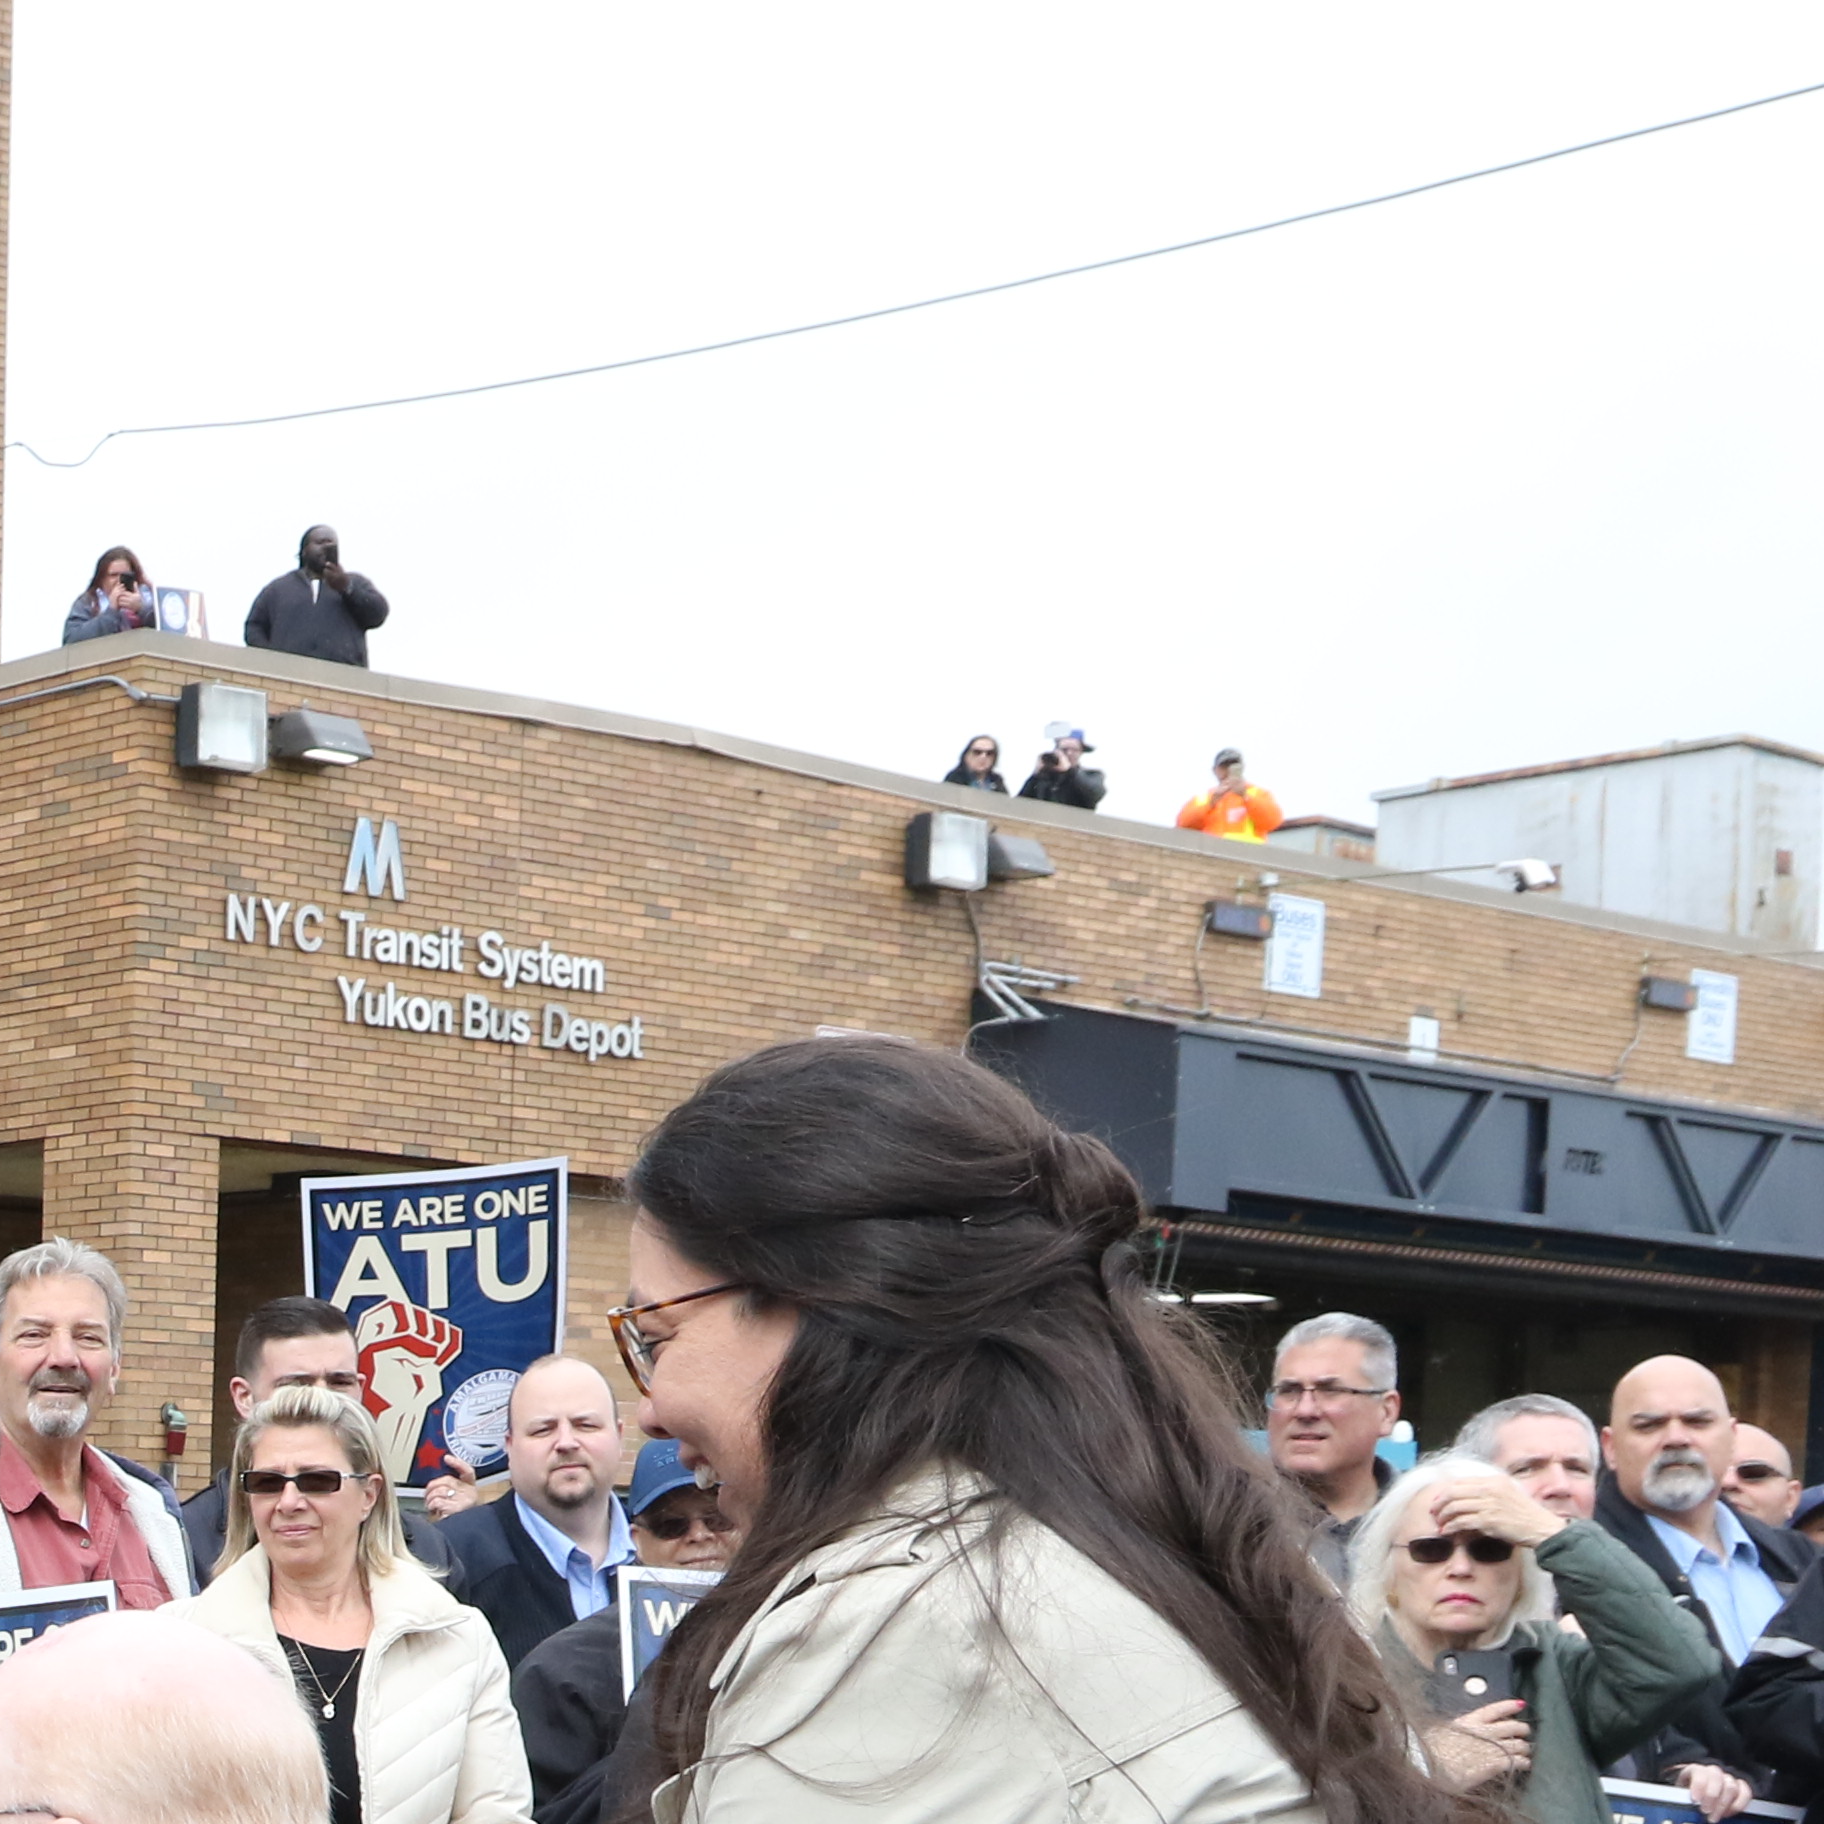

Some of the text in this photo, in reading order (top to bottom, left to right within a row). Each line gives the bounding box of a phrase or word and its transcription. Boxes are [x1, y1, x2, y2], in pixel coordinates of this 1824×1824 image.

[226, 893, 605, 993] NYC Transit System
[335, 975, 644, 1062] Yukon Bus Depot
[321, 1183, 549, 1231] WE ARE ONE
[331, 1218, 549, 1313] ATU
